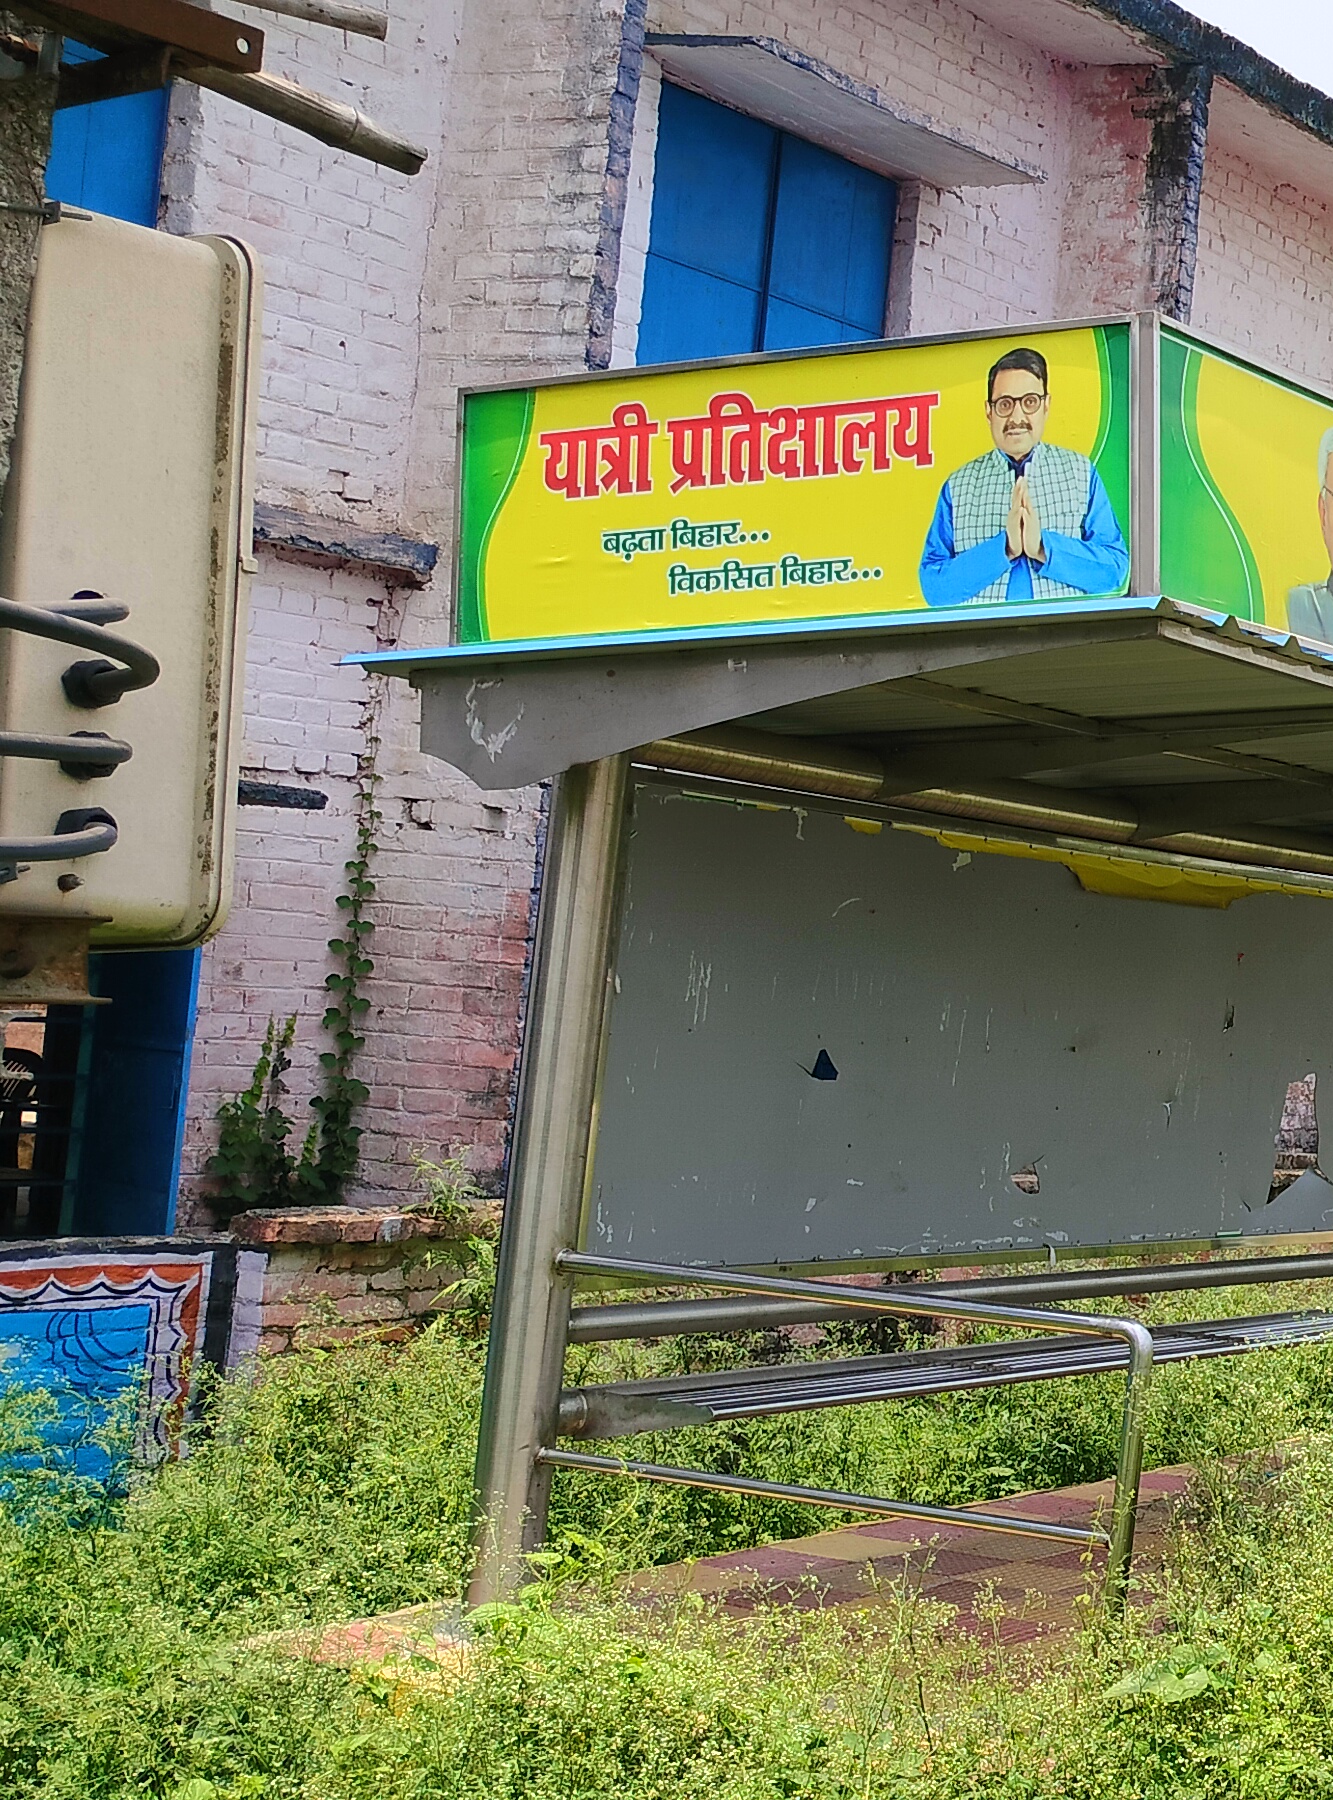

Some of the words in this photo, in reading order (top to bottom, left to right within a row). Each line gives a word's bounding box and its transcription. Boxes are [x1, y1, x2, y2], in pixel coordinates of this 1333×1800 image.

[541, 404, 658, 498] यात्री
[668, 393, 939, 495] प्रतिक्षालय
[603, 526, 667, 561] बढ़ता
[672, 518, 769, 551] बिहार...
[669, 557, 775, 594] विकसित
[781, 555, 881, 587] बिहार...
